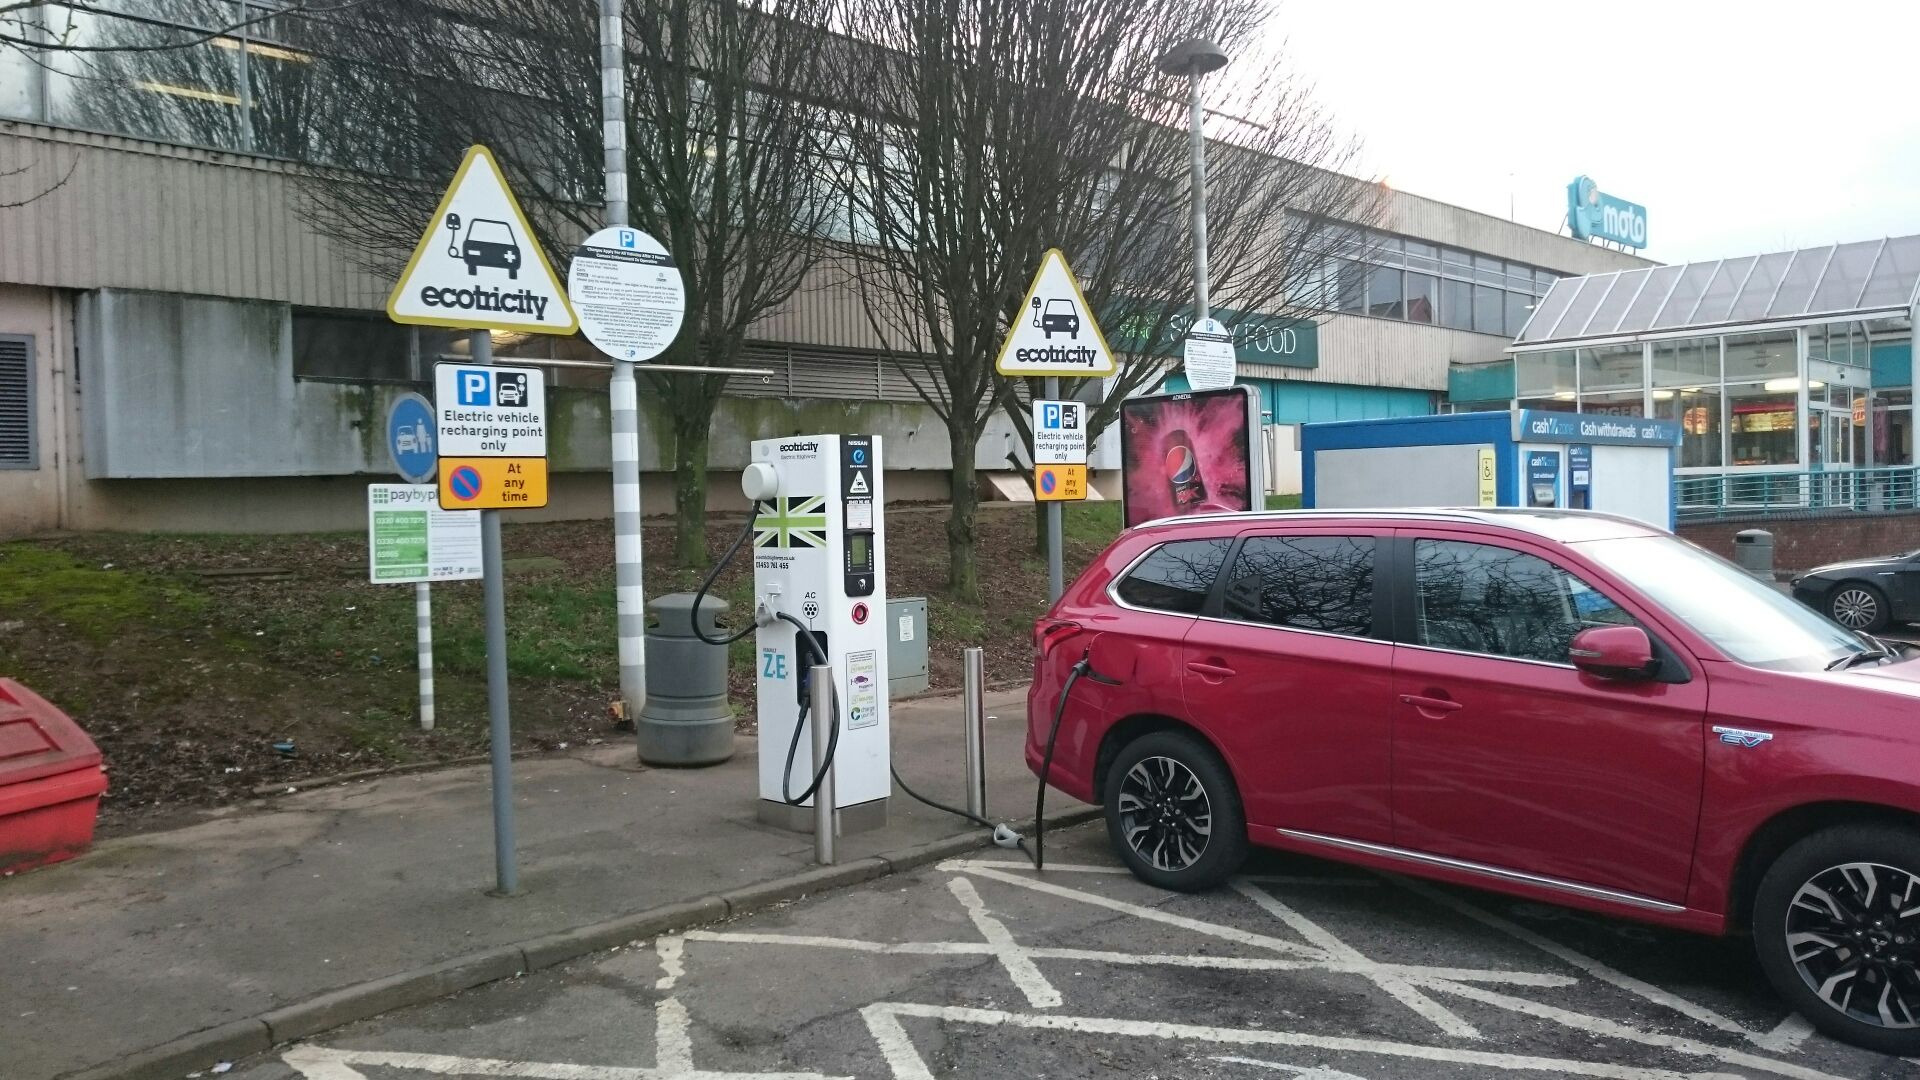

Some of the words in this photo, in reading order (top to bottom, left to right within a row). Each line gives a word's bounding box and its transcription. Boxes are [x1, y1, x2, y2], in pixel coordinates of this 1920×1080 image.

[1603, 204, 1645, 243] moto
[621, 231, 633, 247] P
[421, 284, 548, 321] ecotricity
[1245, 323, 1297, 355] FOOD
[1016, 345, 1096, 367] ecotricity
[465, 374, 486, 403] P
[444, 410, 494, 423] Electric
[497, 411, 539, 424] vehicle
[1046, 406, 1058, 427] P
[441, 425, 508, 439] recharging
[512, 427, 543, 439] point
[1581, 421, 1597, 436] Cash
[1597, 422, 1636, 438] withdrawals
[1037, 431, 1061, 440] Electric
[1062, 432, 1084, 441] vehicle
[480, 440, 507, 452] only
[780, 441, 818, 453] ecotricity
[1036, 442, 1068, 451] recharging
[1069, 443, 1085, 451] point
[1054, 452, 1068, 460] only
[507, 463, 521, 474] At
[1067, 468, 1075, 476] At
[504, 479, 525, 490] any
[1065, 479, 1077, 487] any
[502, 491, 528, 502] time
[1064, 488, 1078, 496] time
[755, 561, 769, 569] 01453
[804, 591, 816, 599] AC
[1720, 733, 1763, 747] EV
